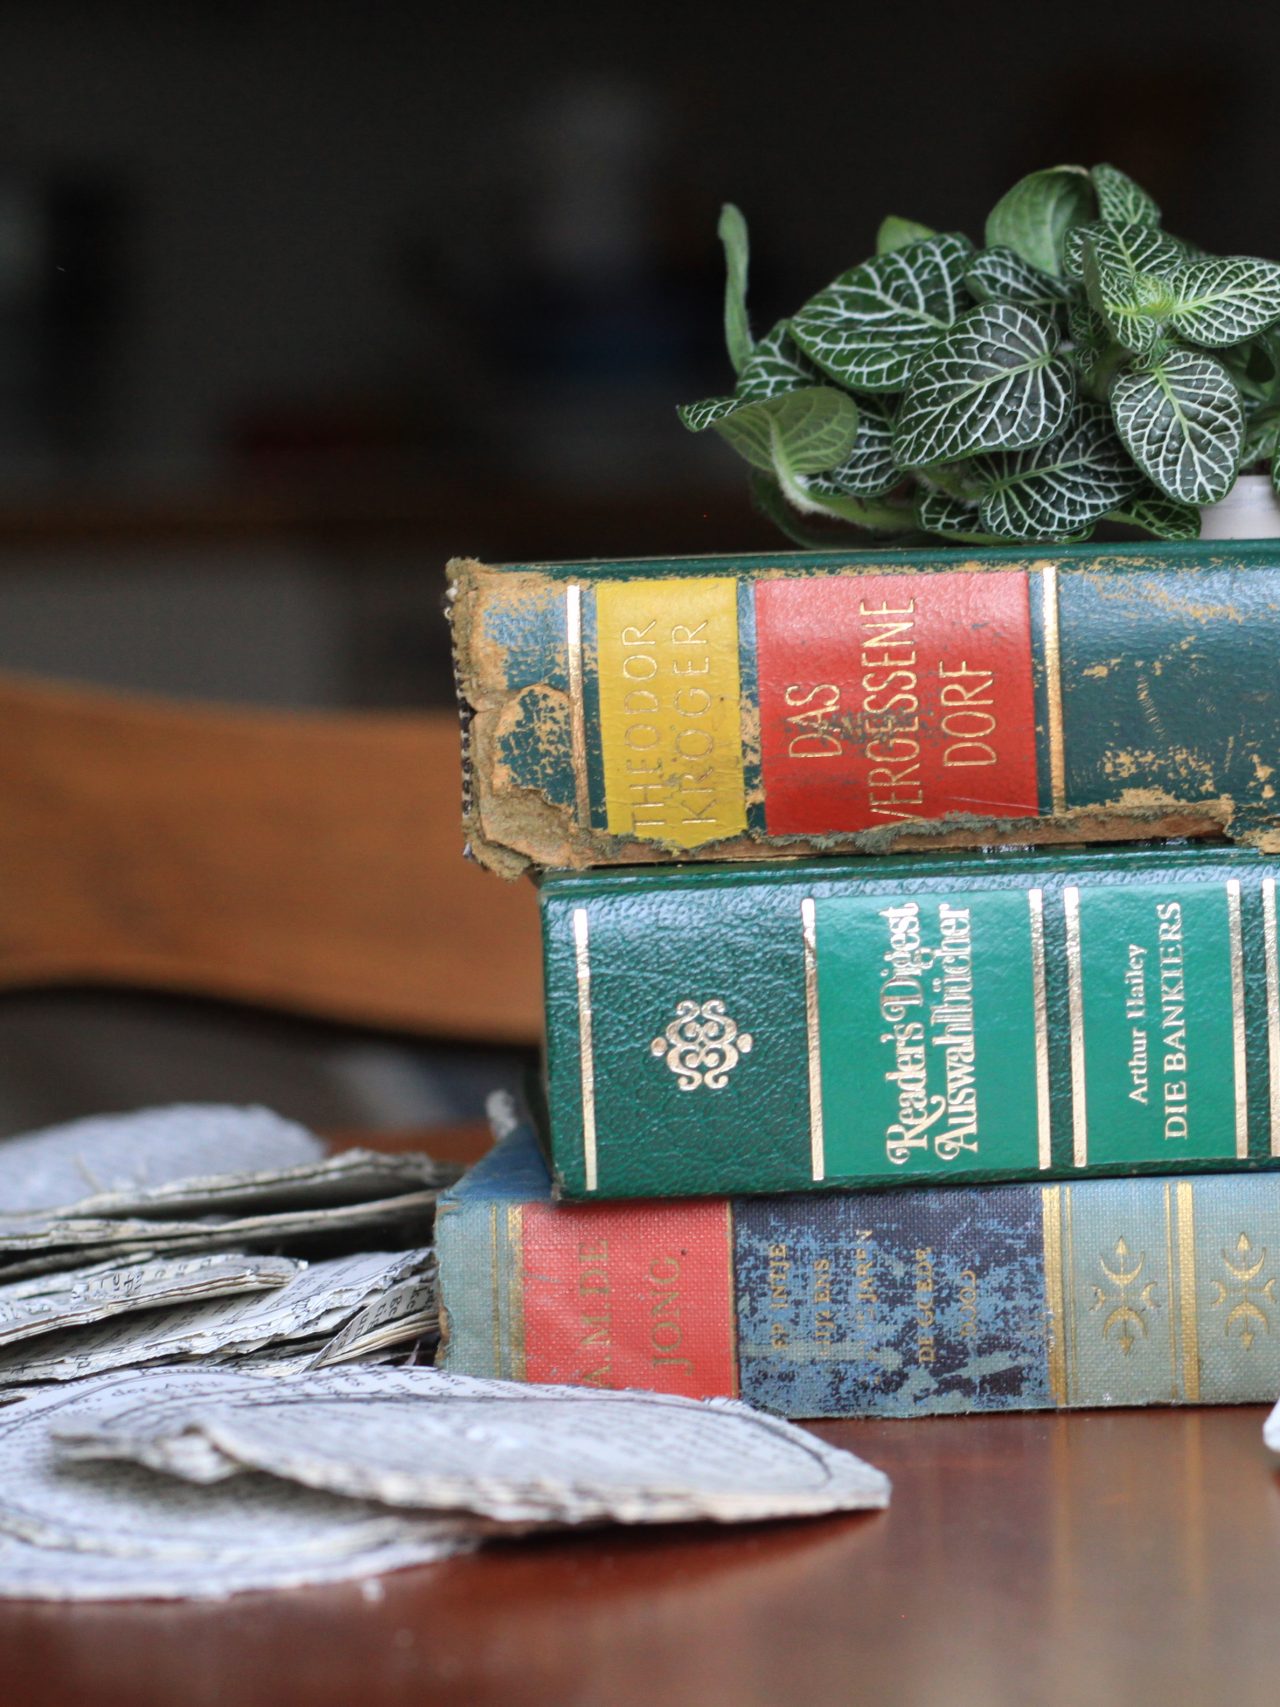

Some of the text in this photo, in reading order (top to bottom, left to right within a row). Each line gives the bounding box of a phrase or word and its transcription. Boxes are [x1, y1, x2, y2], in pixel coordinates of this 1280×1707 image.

[621, 619, 666, 832] THEODOR
[784, 683, 843, 759] DAS
[859, 597, 924, 822] VERGESSENE
[938, 660, 997, 768] DORF
[878, 901, 946, 1164] Reader's Digest
[931, 903, 978, 1161] Auswahlbücher
[1125, 943, 1149, 1105] Arthur Hailey
[1156, 902, 1189, 1140] DIE BANKIERS
[650, 1256, 696, 1377] JONG
